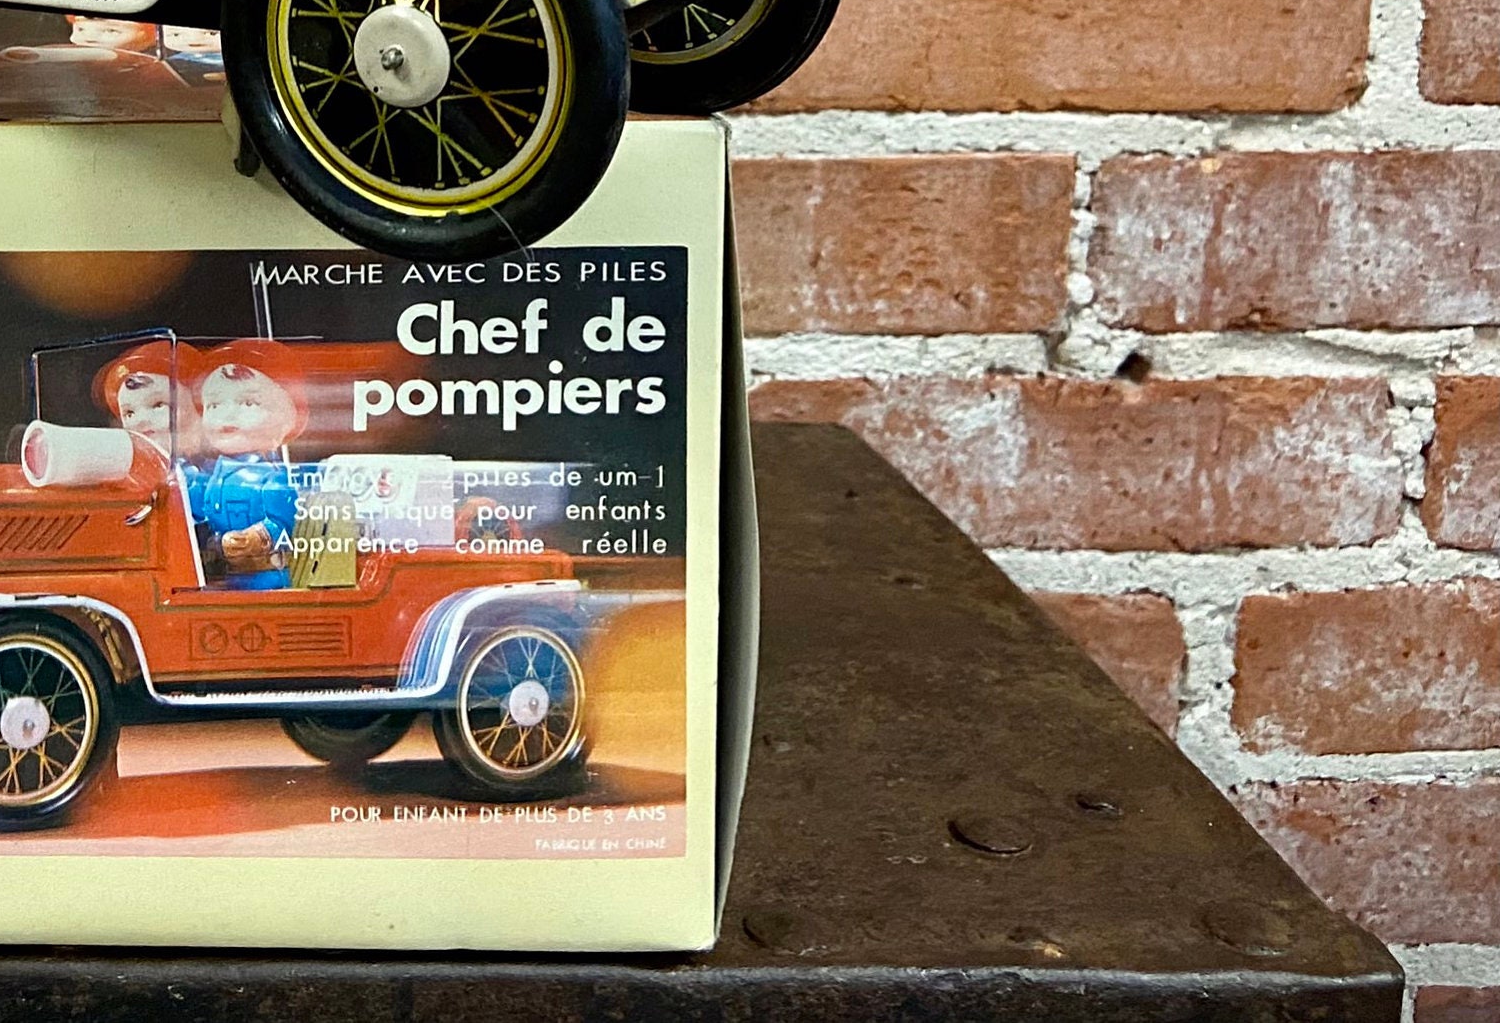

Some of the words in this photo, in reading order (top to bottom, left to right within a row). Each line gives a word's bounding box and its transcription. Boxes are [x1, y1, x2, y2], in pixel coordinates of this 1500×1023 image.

[252, 262, 383, 284] MARCHE
[401, 263, 486, 284] AVEC
[503, 262, 561, 282] DES
[580, 261, 667, 281] PILES
[397, 298, 548, 355] Chef
[583, 297, 666, 352] de
[352, 360, 666, 431] pompiers
[464, 466, 532, 493] piles
[550, 462, 582, 486] de
[294, 498, 351, 520] Sans
[478, 504, 537, 526] pour
[566, 496, 666, 520] enfants
[274, 529, 418, 559] Apparence
[455, 538, 544, 555] comme
[582, 529, 667, 555] réelle
[330, 807, 381, 823] POUR
[394, 807, 467, 823] ENFANT
[479, 807, 503, 823] DE
[515, 806, 557, 823] PLUS
[568, 806, 593, 823] DE
[603, 809, 614, 825] 3
[626, 806, 666, 822] ANS
[602, 839, 619, 851] EN
[626, 837, 667, 850] CHINE
